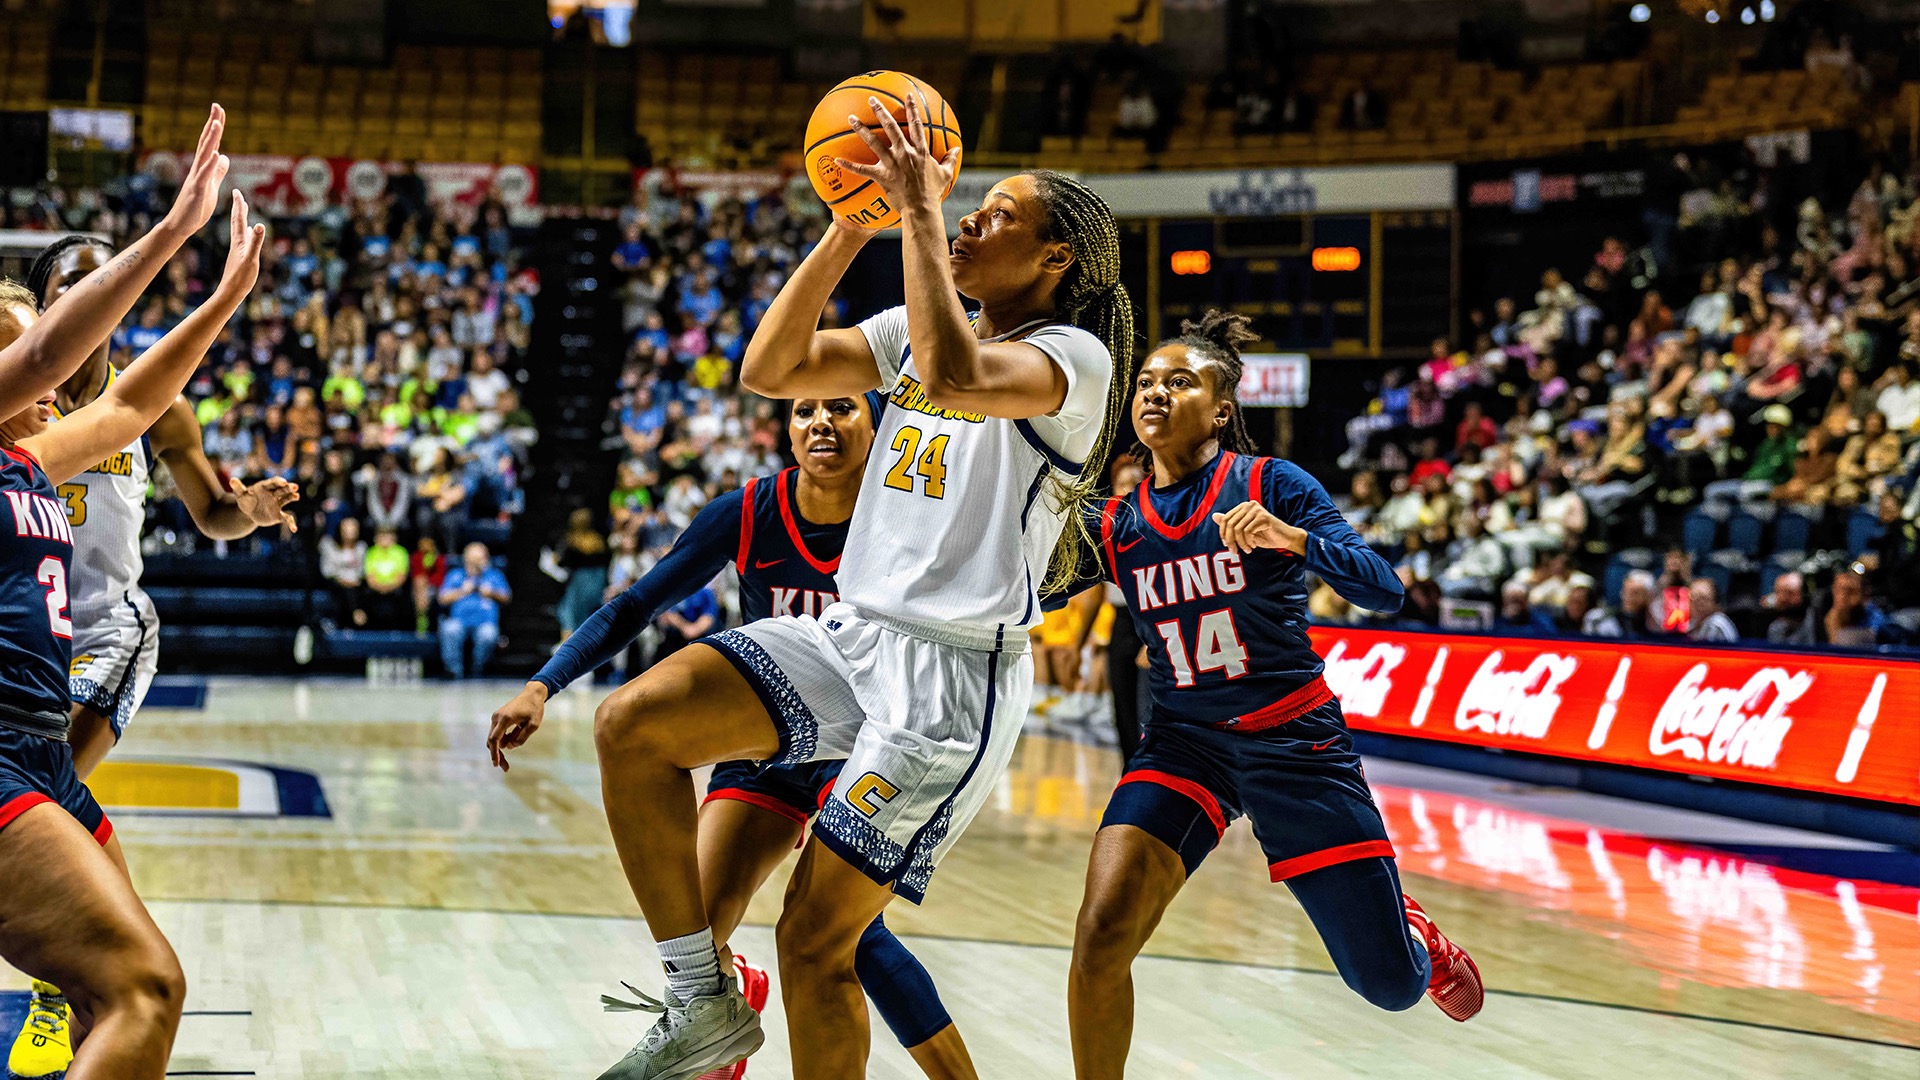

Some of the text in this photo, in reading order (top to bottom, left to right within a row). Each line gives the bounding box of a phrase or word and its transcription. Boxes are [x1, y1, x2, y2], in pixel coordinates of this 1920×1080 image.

[883, 425, 951, 500] 24
[36, 554, 73, 640] 2
[1132, 550, 1248, 612] KING
[1155, 607, 1250, 688] 14
